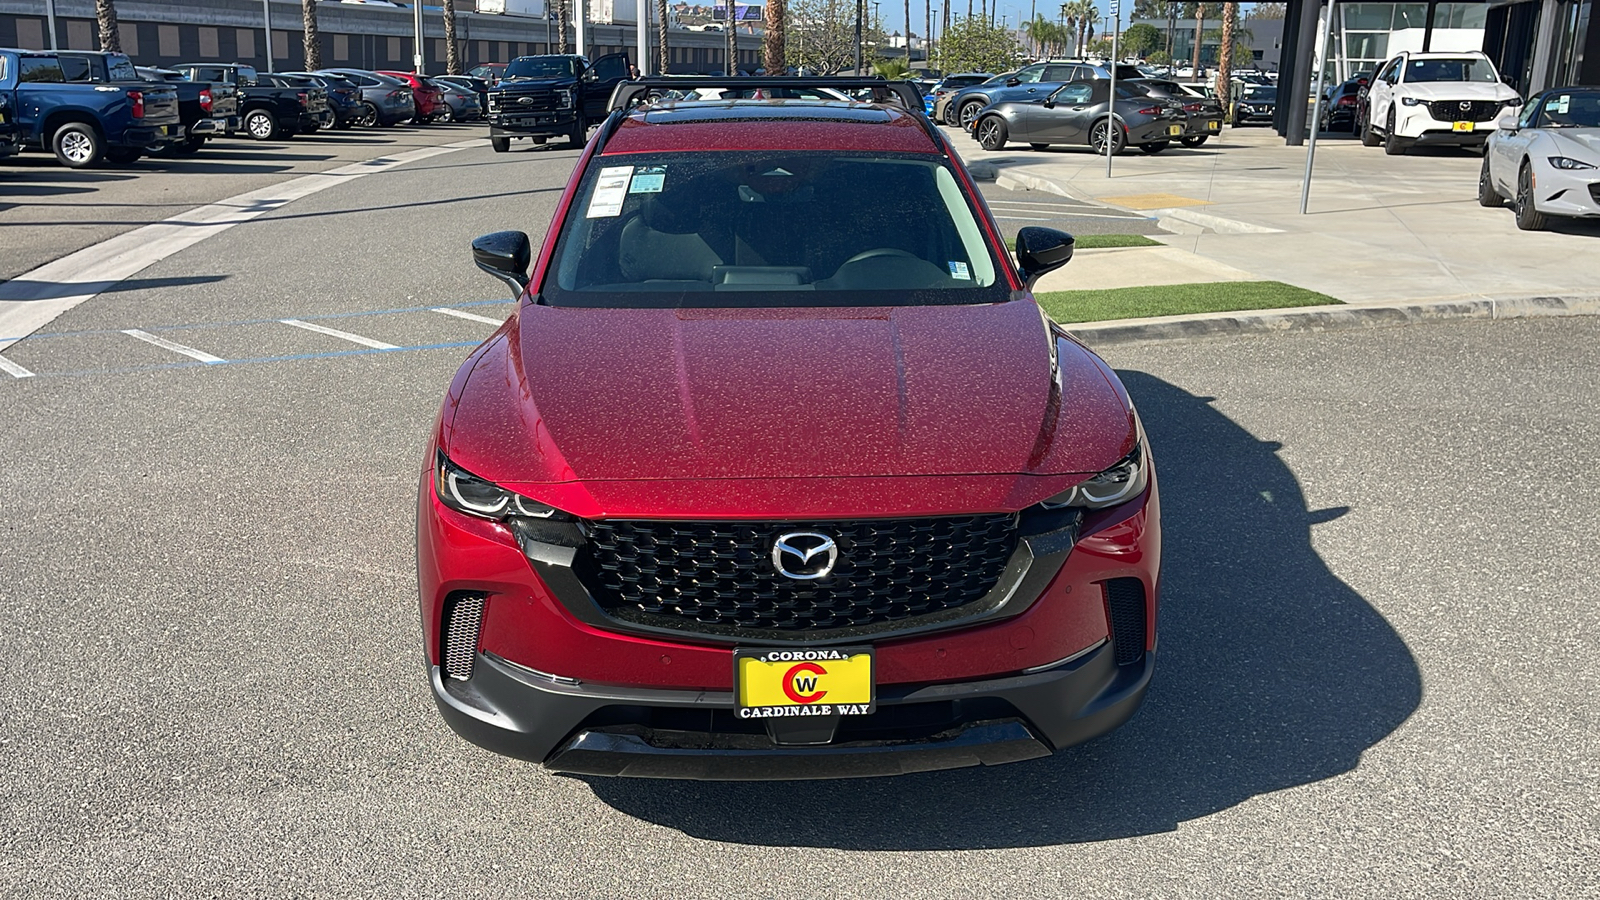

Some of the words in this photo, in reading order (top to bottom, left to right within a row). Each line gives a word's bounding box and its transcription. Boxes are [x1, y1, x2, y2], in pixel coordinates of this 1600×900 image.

[768, 650, 841, 661] CORONA
[740, 705, 832, 718] CARDINALE
[837, 704, 870, 715] WAY
